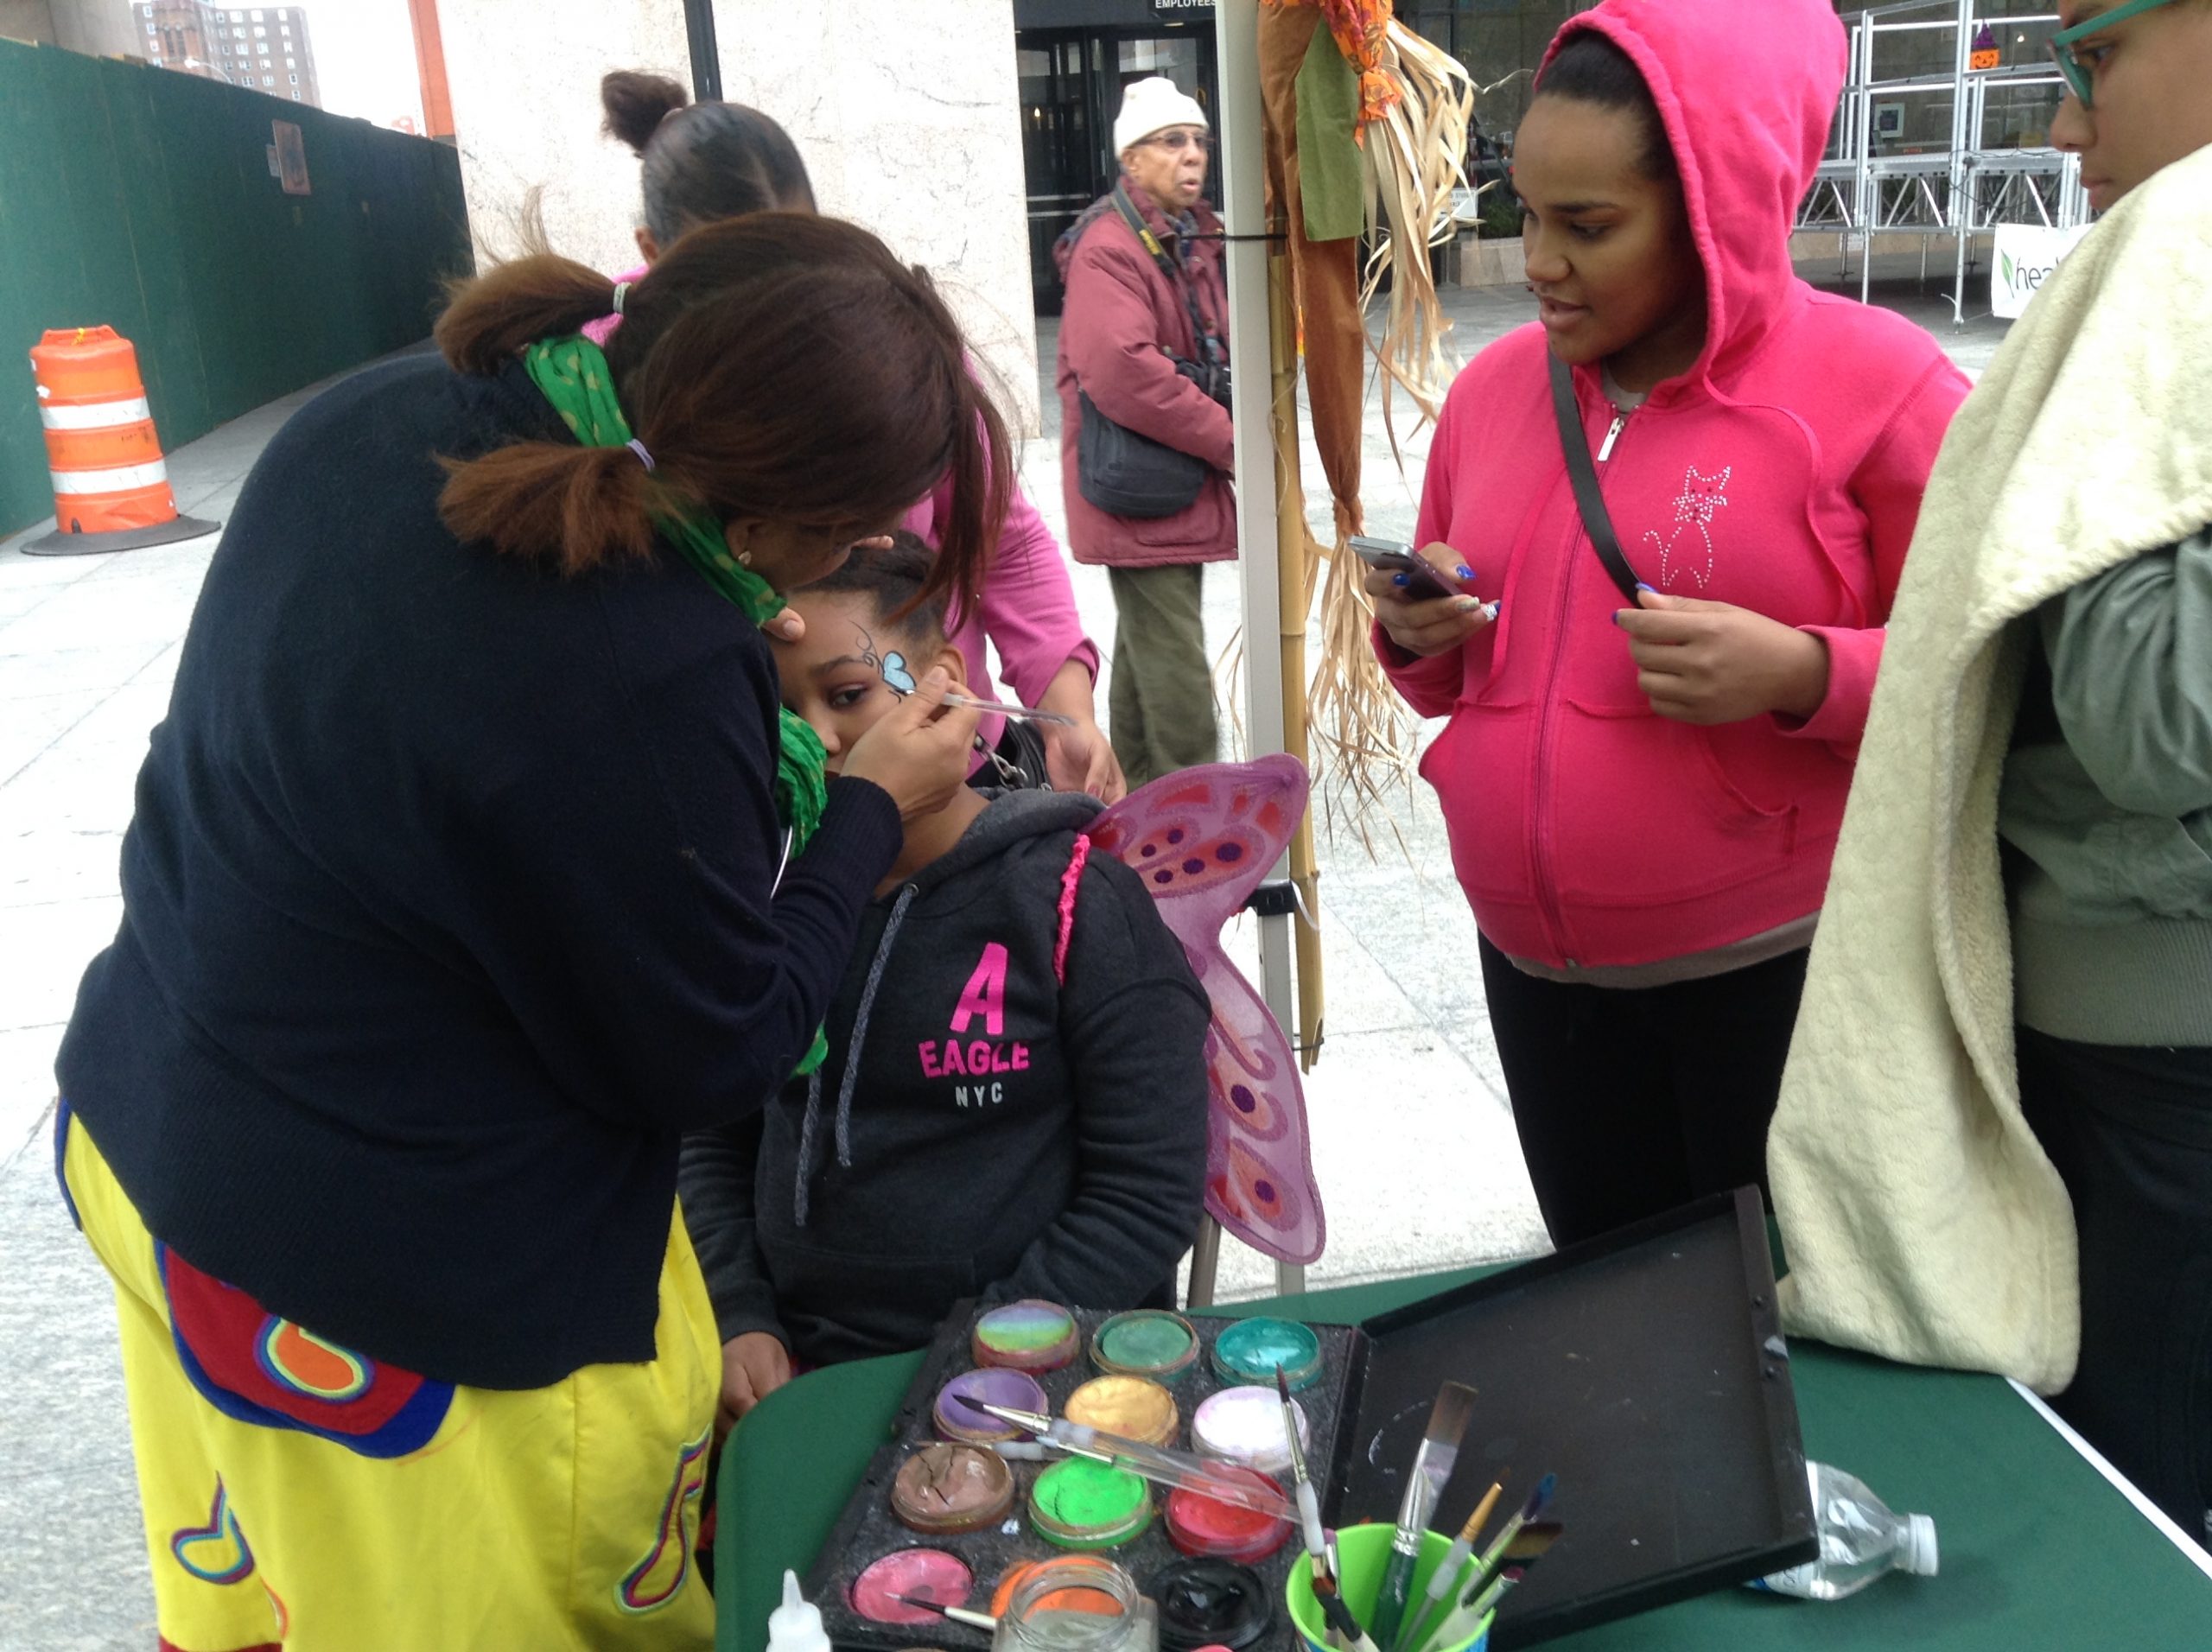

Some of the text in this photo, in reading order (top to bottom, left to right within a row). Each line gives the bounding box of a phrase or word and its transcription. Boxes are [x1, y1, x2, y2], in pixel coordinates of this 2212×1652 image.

[2016, 257, 2060, 290] he
[950, 942, 1008, 1036] A
[918, 1039, 1030, 1078] EAGLE
[955, 1082, 1003, 1108] NYC
